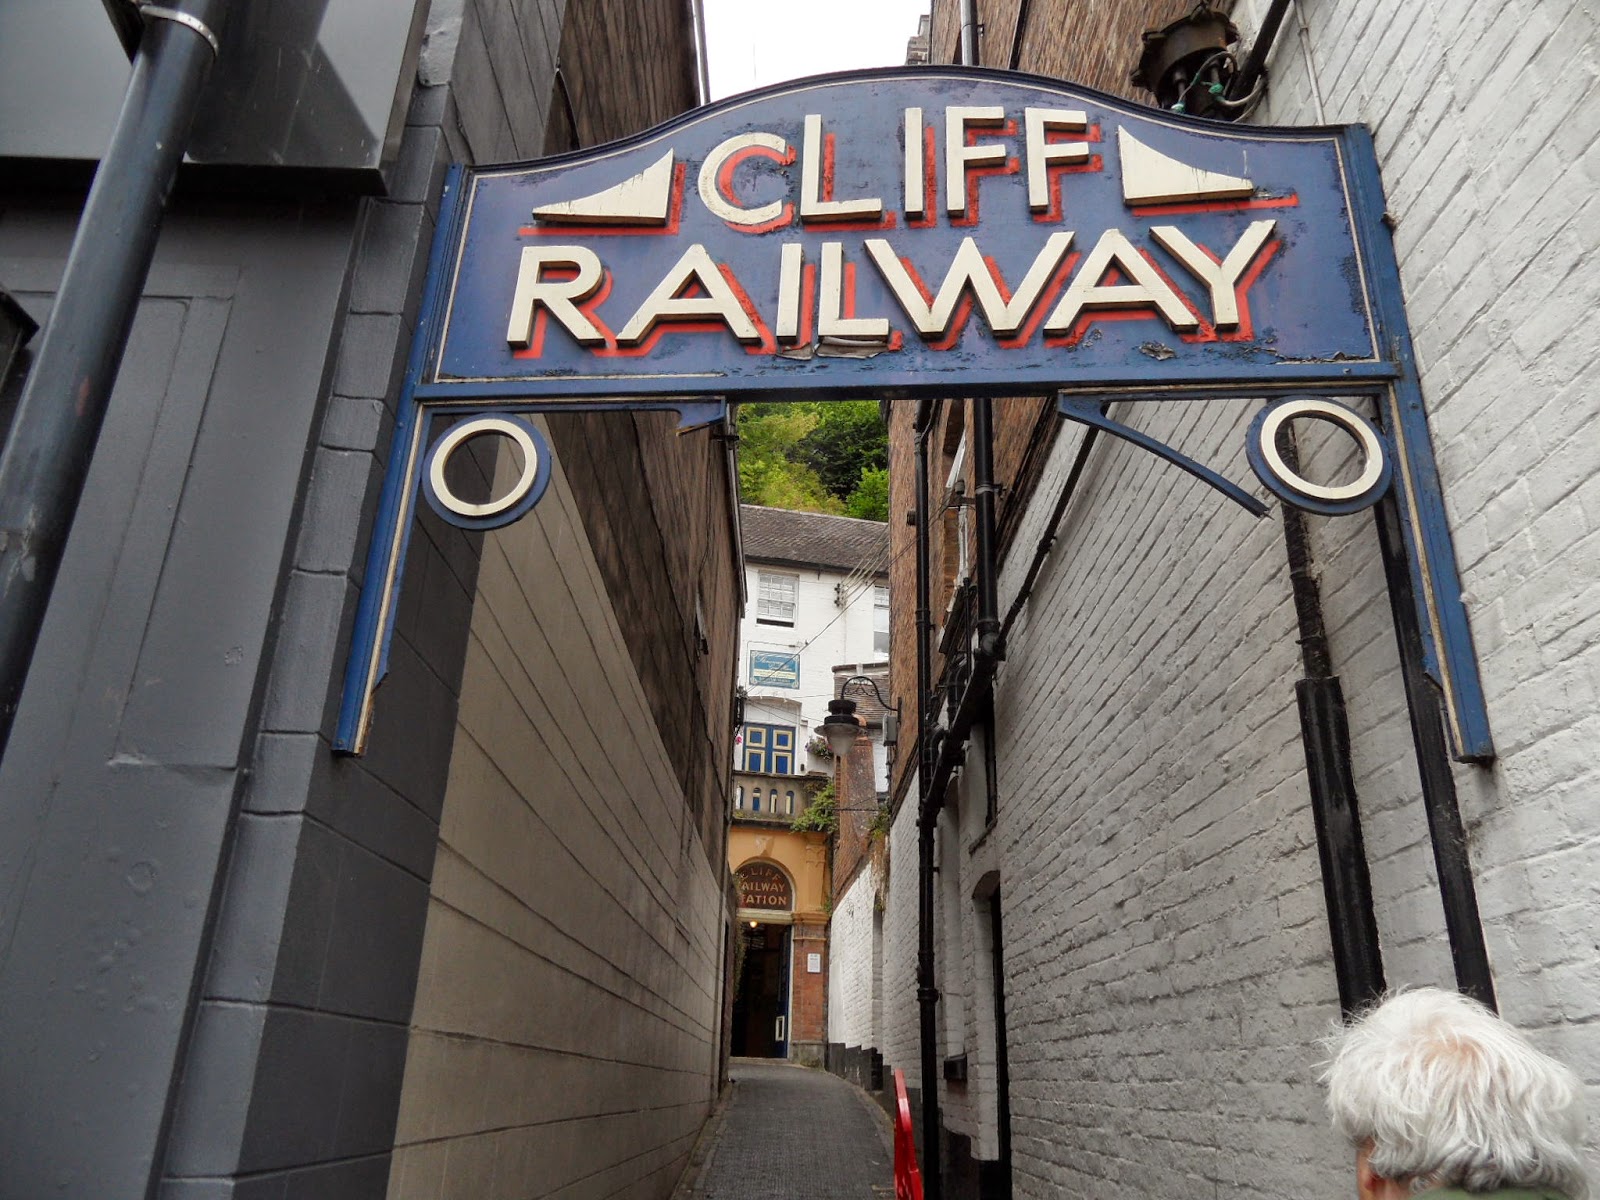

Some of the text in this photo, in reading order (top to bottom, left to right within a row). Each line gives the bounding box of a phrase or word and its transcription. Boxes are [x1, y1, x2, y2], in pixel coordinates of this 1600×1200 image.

[698, 105, 1091, 225] CLIFF
[506, 219, 1277, 349] RAILWAY
[738, 881, 785, 893] AILWAY
[739, 894, 787, 906] TATION
